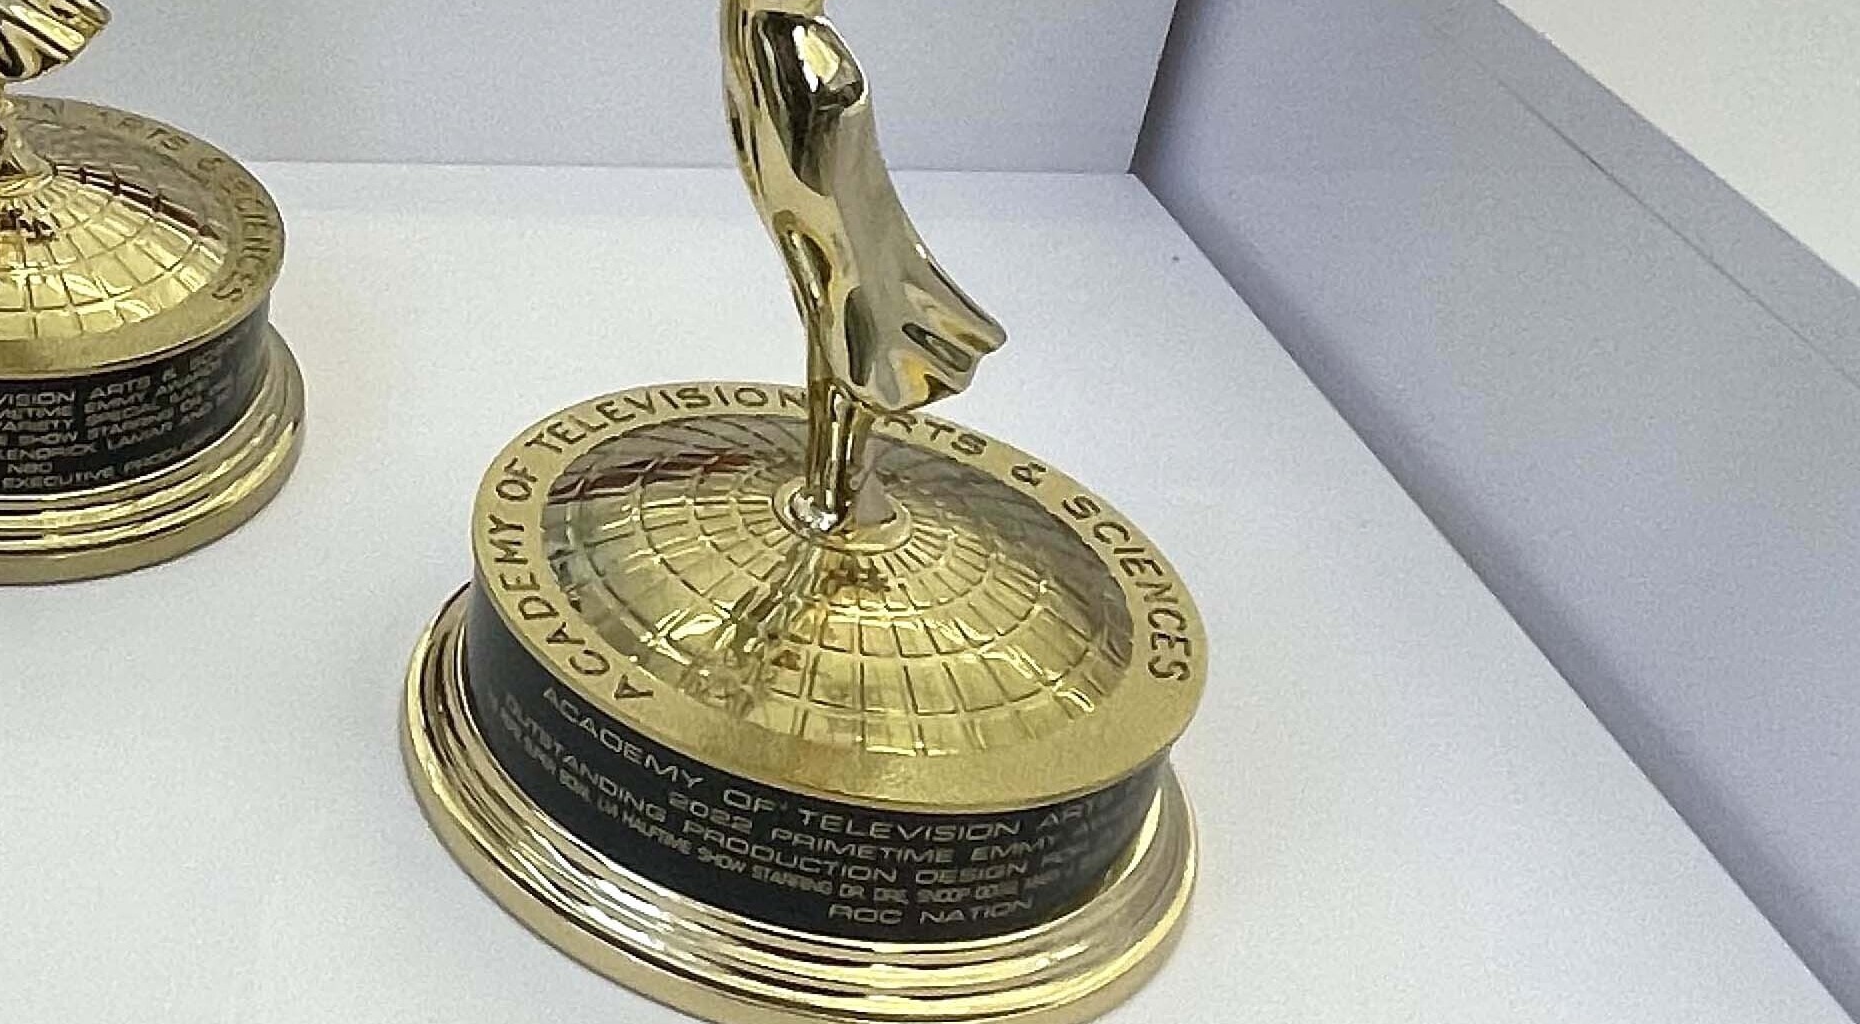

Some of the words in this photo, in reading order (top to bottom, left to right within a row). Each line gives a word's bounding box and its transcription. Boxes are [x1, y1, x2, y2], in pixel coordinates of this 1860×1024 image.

[89, 376, 152, 400] ARTS
[18, 431, 78, 446] SHOW
[524, 384, 807, 455] TELEVISION
[884, 412, 988, 456] RTS
[2, 466, 115, 489] EXECUTIVE
[6, 462, 53, 474] NBC
[495, 456, 539, 503] OF
[1011, 462, 1047, 487] &
[487, 512, 654, 701] ACADEMY
[1062, 494, 1192, 681] SCIENCES
[543, 686, 705, 789] ACADEMY
[723, 789, 775, 814] OF
[797, 807, 1021, 842] TELEVISION
[506, 692, 667, 823] OUTSTANDING
[682, 818, 898, 884] PRODUCTION
[915, 861, 1029, 885] DESIGN
[667, 791, 754, 836] 2022
[770, 826, 952, 864] PRIMETIME
[622, 810, 691, 856] HALFTIME
[697, 844, 748, 873] SHOW
[751, 864, 833, 896] STARRING
[916, 886, 971, 903] SNOOP
[827, 903, 903, 925] ROC
[919, 894, 1034, 925] NATION
